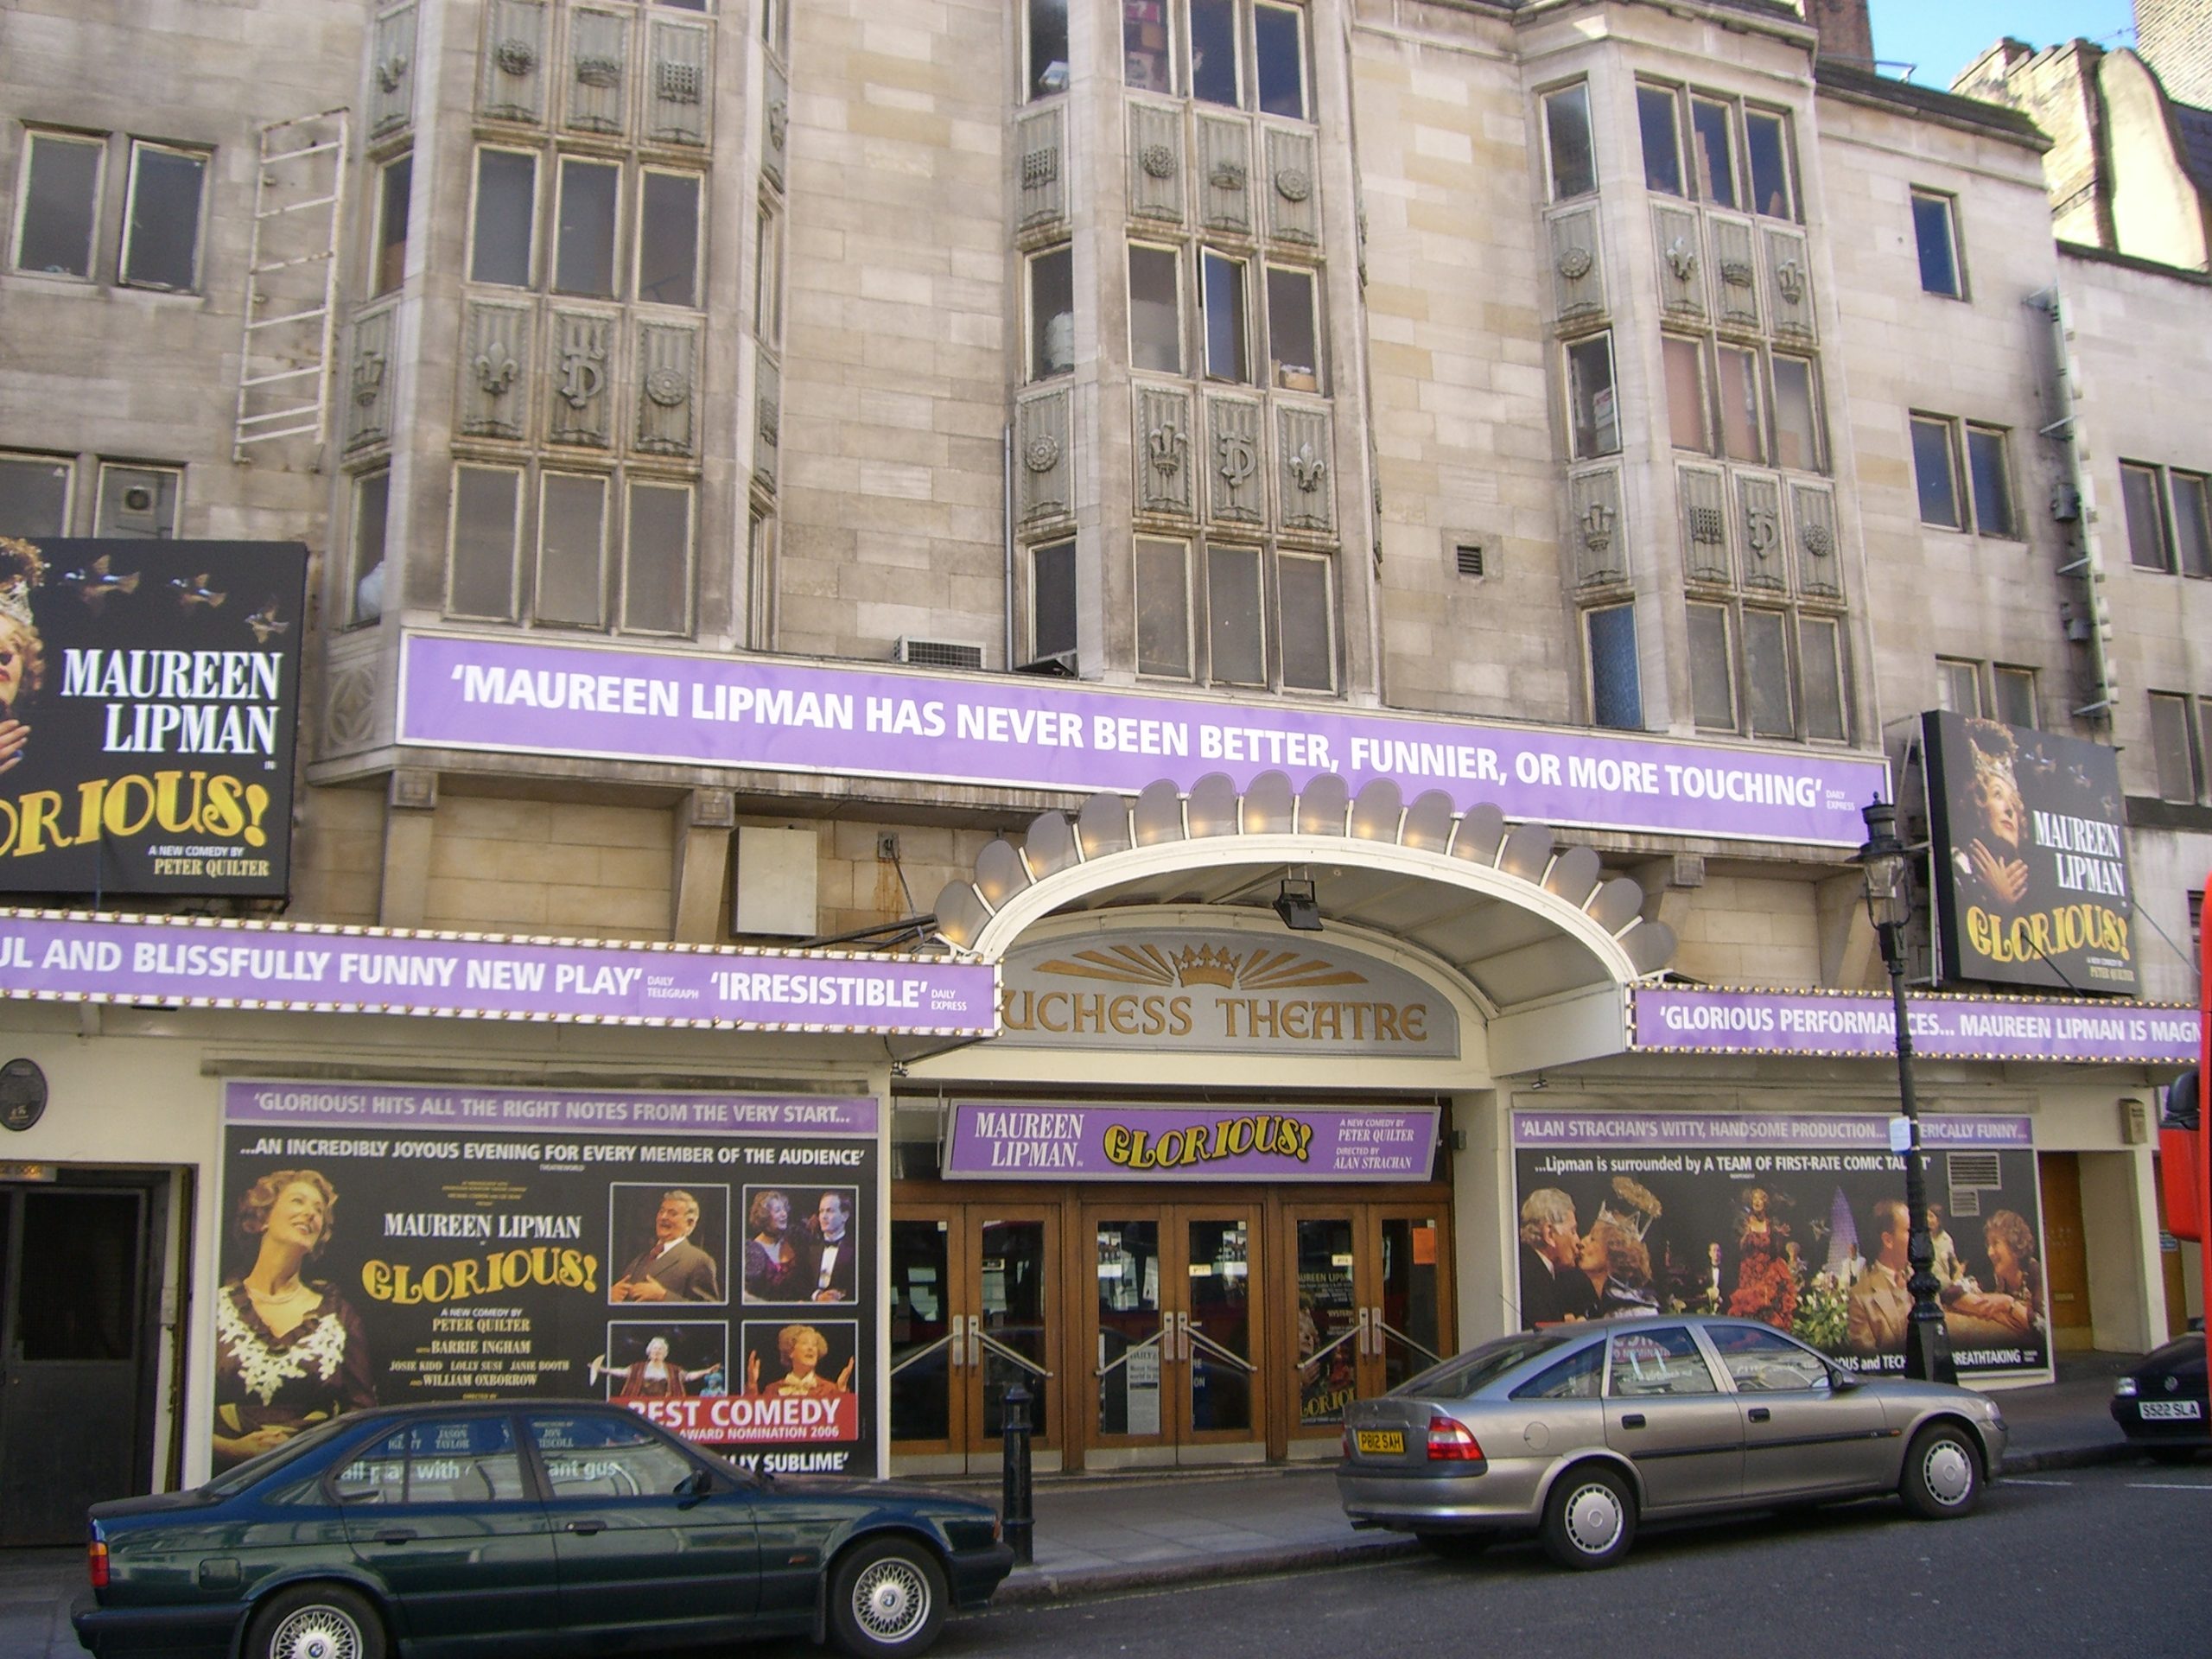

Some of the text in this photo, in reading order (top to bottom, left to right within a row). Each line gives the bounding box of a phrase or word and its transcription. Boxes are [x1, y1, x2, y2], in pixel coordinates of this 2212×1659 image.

[60, 649, 284, 700] MAUREEN
[103, 703, 281, 754] LIPMAN
[450, 664, 1822, 808] 'MAUREEN LIPMAN HAS NEVER BEEN BETTER, FUNNIER, OR MORE TOUCHING'
[1826, 789, 1846, 799] DAILY
[1826, 800, 1855, 811] EXPRESS
[2033, 810, 2121, 859] MAUREEN
[149, 846, 244, 856] A NEW COMEDY BY
[154, 858, 270, 878] PETER QUILTER
[2055, 852, 2125, 896] LIPMAN
[1967, 903, 2130, 963] GLORIOUS!
[41, 939, 122, 972] AND
[133, 942, 330, 982] BLISSFULLY
[339, 952, 458, 988] FUNNY
[466, 959, 546, 992] NEW
[556, 963, 643, 997] PLAY'
[647, 976, 673, 988] DAILY
[647, 988, 699, 1000] TELEGRAPH
[931, 989, 957, 1001] DAILY
[931, 1001, 967, 1012] EXPRESS
[1001, 989, 1427, 1042] UCHESS THEATRE
[1960, 1014, 2051, 1040] MAUREEN
[2056, 1017, 2125, 1040] LIPMAN
[2130, 1020, 2147, 1041] IS
[372, 1096, 414, 1115] HITS
[420, 1097, 454, 1116] ALL
[461, 1099, 497, 1116] THE
[503, 1100, 559, 1118] RIGHT
[566, 1102, 626, 1121] NOTES
[633, 1103, 687, 1122] FROM
[693, 1103, 727, 1122] THE
[734, 1104, 779, 1122] VERY
[785, 1105, 850, 1123] START...
[975, 1112, 1084, 1139] MAUREEN
[1568, 1122, 1658, 1137] STRACHAN'S
[1662, 1122, 1706, 1139] WITTY,
[1710, 1122, 1788, 1137] HANDSOME
[1103, 1115, 1313, 1168] GLORIOUS!
[1338, 1129, 1414, 1143] PETER QUILTER
[287, 1139, 388, 1157] INCREDIBLY
[392, 1141, 458, 1159] JOYOUS
[464, 1142, 539, 1160] EVENING
[544, 1144, 578, 1160] FOR
[583, 1145, 638, 1162] EVERY
[640, 1147, 713, 1163] MEMBER
[718, 1147, 740, 1164] OF
[744, 1147, 774, 1165] THE
[991, 1141, 1078, 1166] LIPMAN
[1333, 1157, 1412, 1169] ALAN STRACHAN
[1597, 1157, 1607, 1172] is
[1611, 1156, 1682, 1172] surrounded
[1686, 1156, 1701, 1175] by
[1704, 1157, 1714, 1171] A
[1716, 1157, 1752, 1171] TEAM
[1755, 1157, 1773, 1171] OF
[1776, 1156, 1840, 1171] FIRST-RATE
[1844, 1156, 1883, 1171] COMIC
[385, 1213, 582, 1239] MAUREEN LIPMAN
[362, 1247, 598, 1304] GLORIOUS!
[511, 1308, 523, 1317] BY
[432, 1319, 531, 1333] PETER QUILTER
[432, 1340, 478, 1354] BARRIE
[482, 1340, 531, 1354] INGHAM
[1860, 1355, 1880, 1370] and
[423, 1374, 473, 1386] WILLIAM
[711, 1398, 840, 1426] COMEDY
[728, 1427, 806, 1440] NOMINATION
[810, 1426, 839, 1438] 2006
